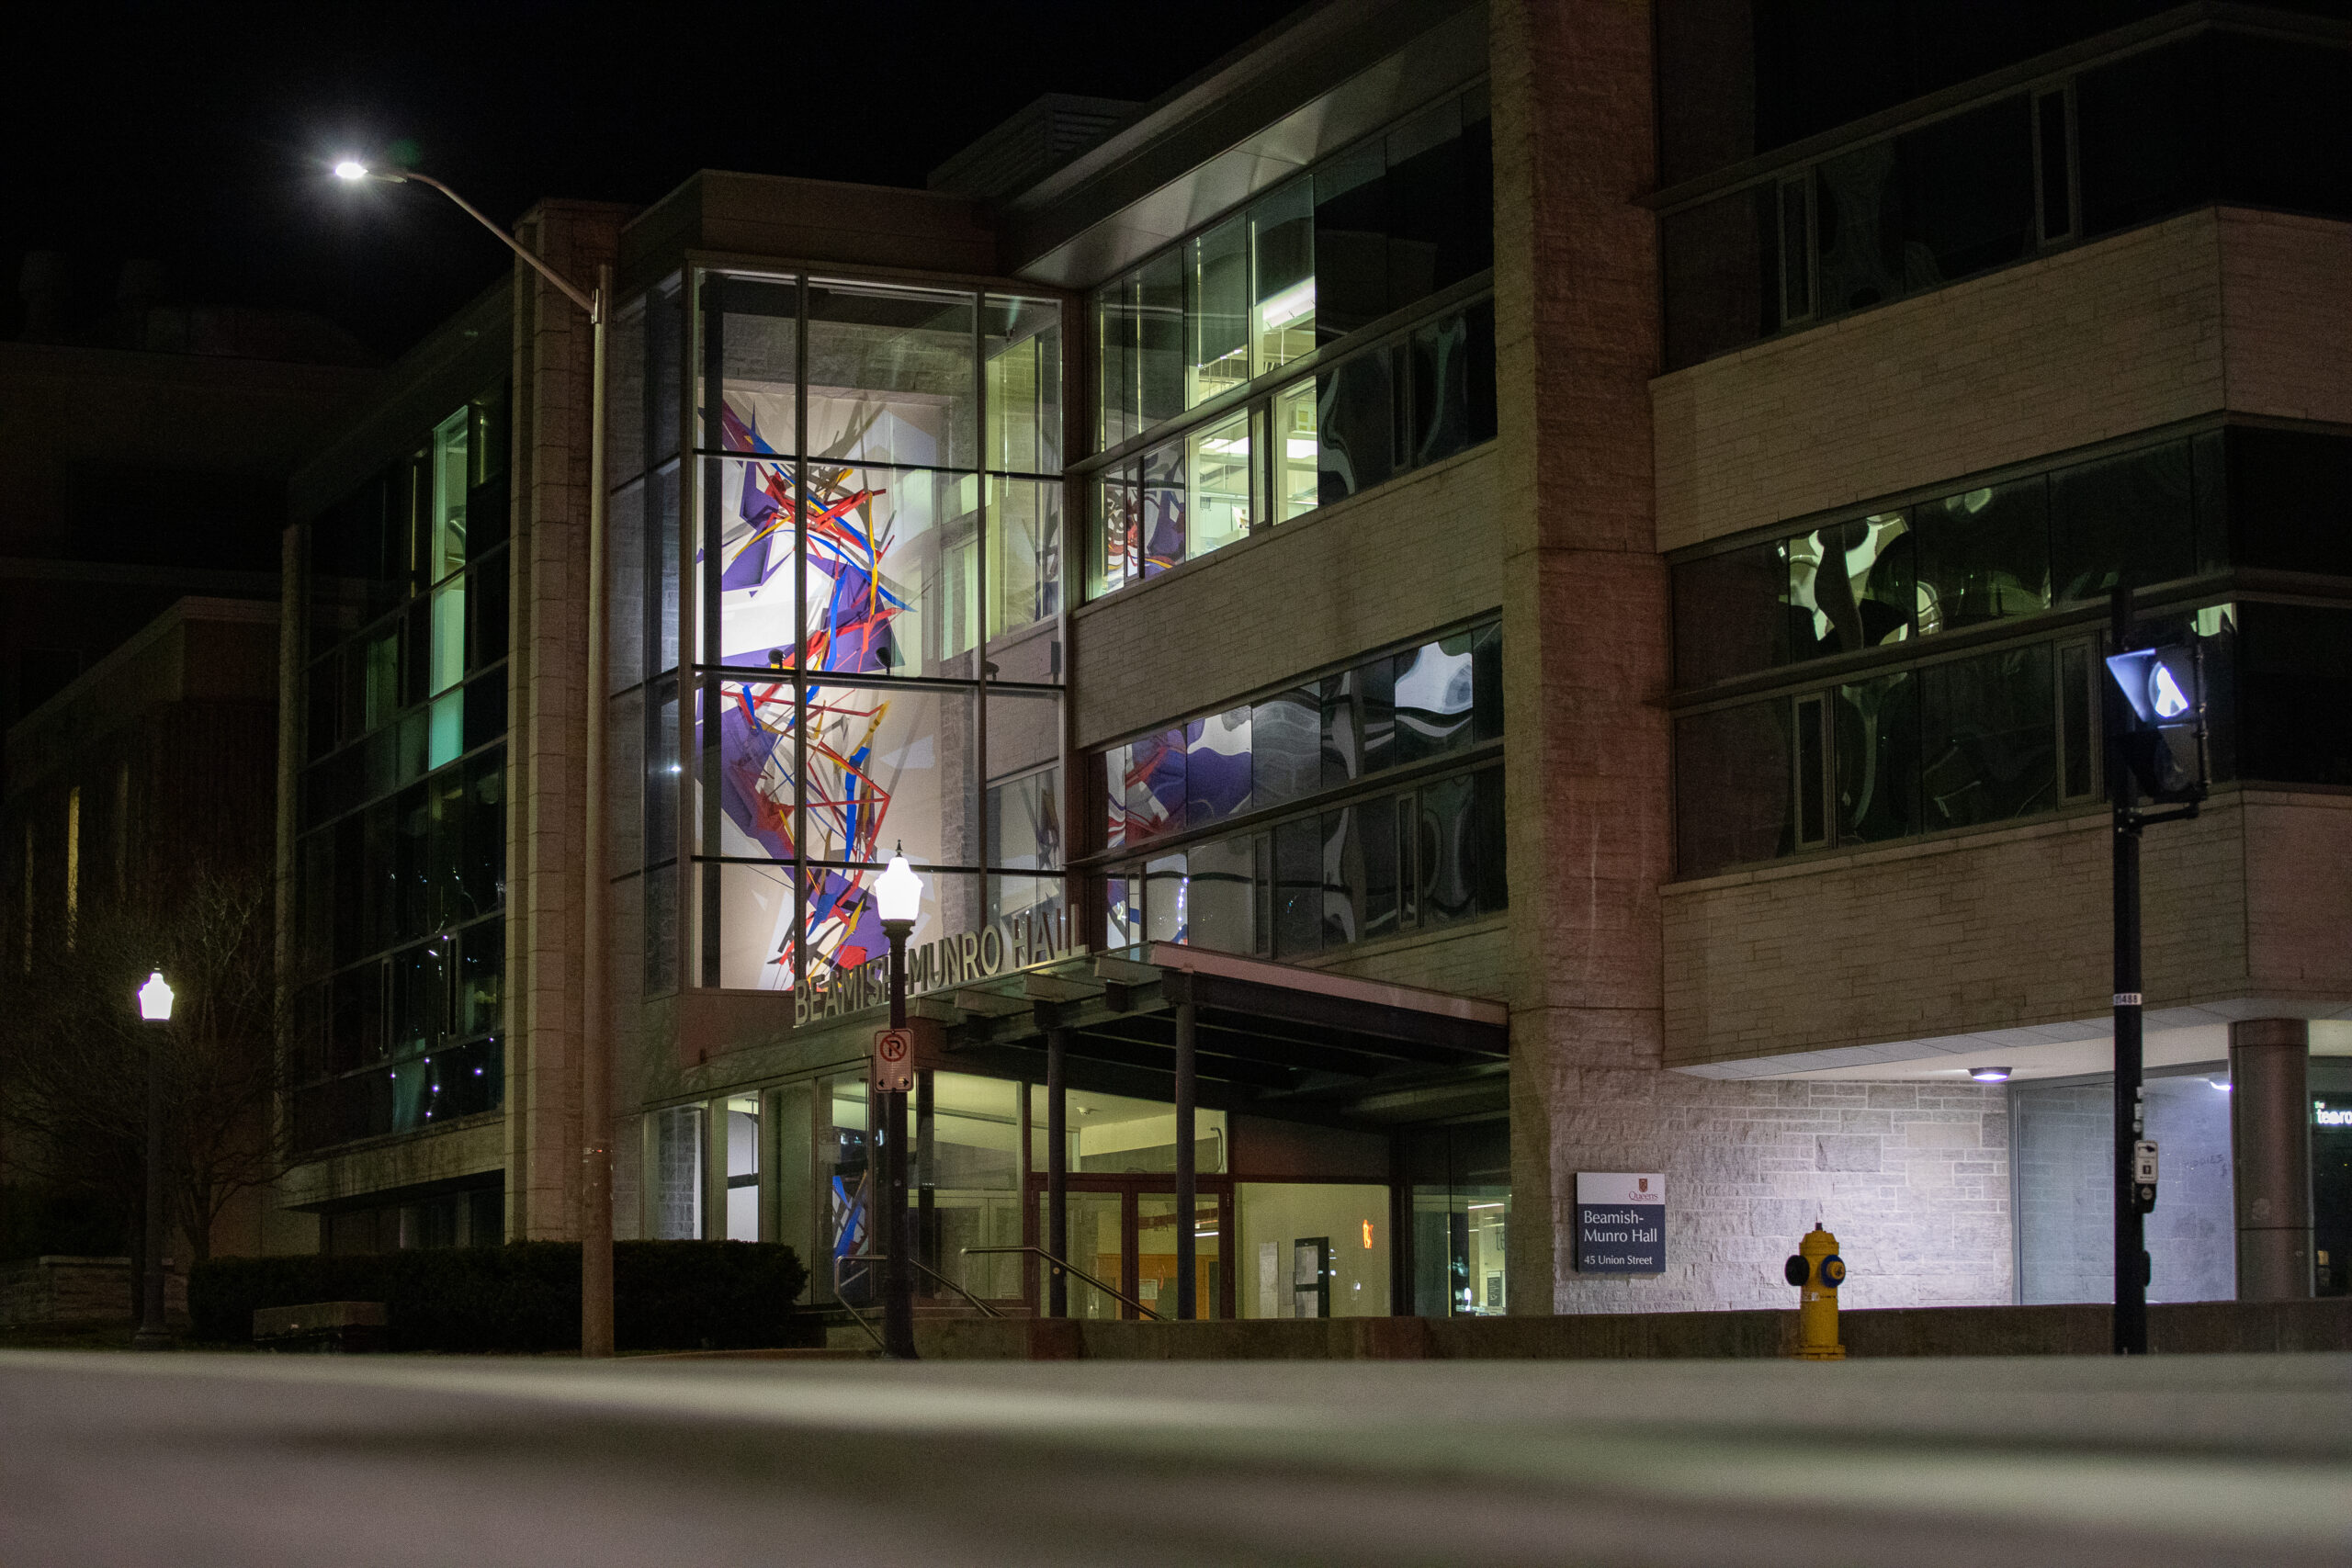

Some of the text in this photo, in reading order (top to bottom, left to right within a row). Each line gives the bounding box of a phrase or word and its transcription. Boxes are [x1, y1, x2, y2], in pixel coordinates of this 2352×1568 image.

[908, 924, 1003, 996] MUNRO
[1012, 904, 1089, 969] HALL
[1584, 1210, 1645, 1224] Beamish-
[1584, 1228, 1657, 1242] Munro Hall
[1584, 1255, 1653, 1265] 45 Union Street
